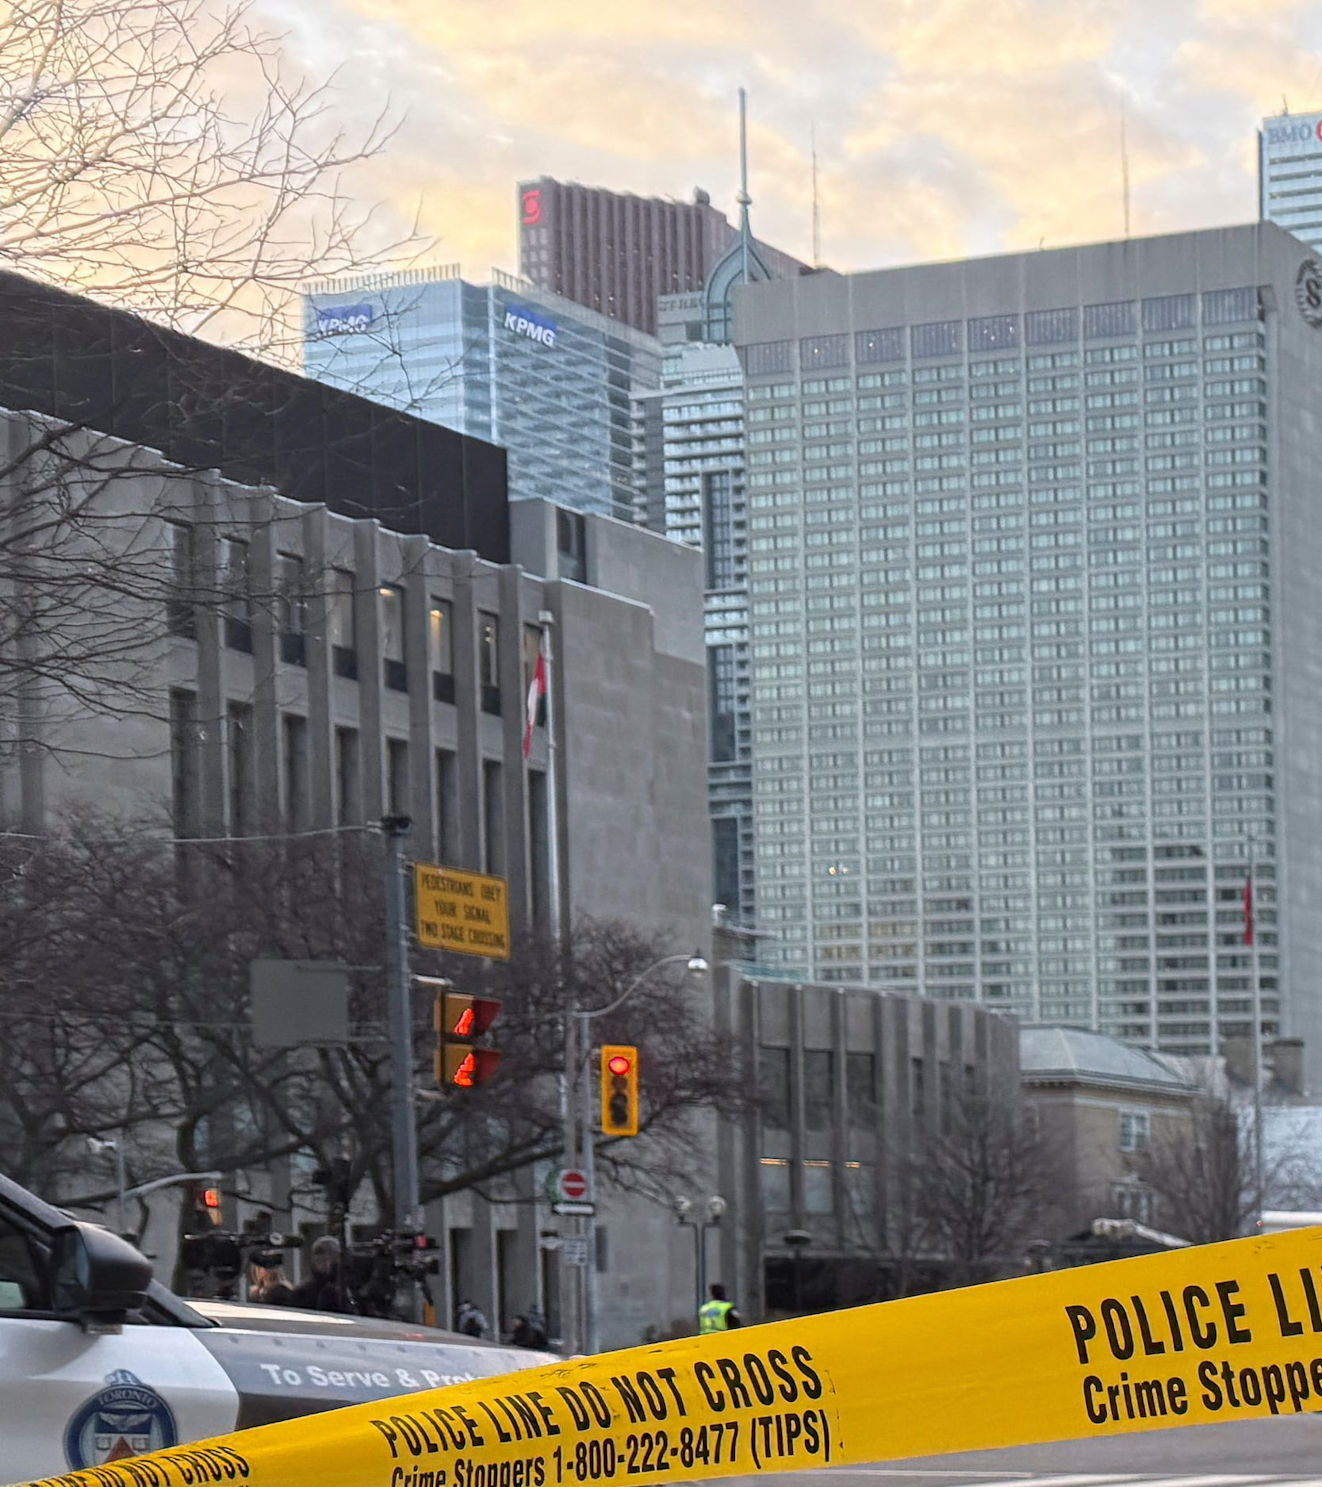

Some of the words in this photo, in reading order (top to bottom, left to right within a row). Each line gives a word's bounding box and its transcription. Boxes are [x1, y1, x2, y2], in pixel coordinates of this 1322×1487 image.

[1268, 123, 1313, 144] BMO
[504, 312, 557, 347] KPMG
[1065, 1279, 1252, 1365] POLICE
[260, 1363, 301, 1385] To
[305, 1365, 391, 1388] Serve
[396, 1368, 420, 1388] &
[420, 1369, 484, 1388] Prot
[99, 1389, 158, 1409] TORONTO
[370, 1405, 484, 1458] POLICE
[491, 1390, 560, 1443] LINE
[557, 1381, 611, 1431] DO
[611, 1368, 687, 1424] NOT
[692, 1345, 822, 1412] CROSS
[1083, 1374, 1190, 1424] Crime
[163, 1446, 250, 1485] CROSS
[552, 1420, 739, 1484] 1-800-222-8477
[750, 1408, 830, 1469] (TIPS)
